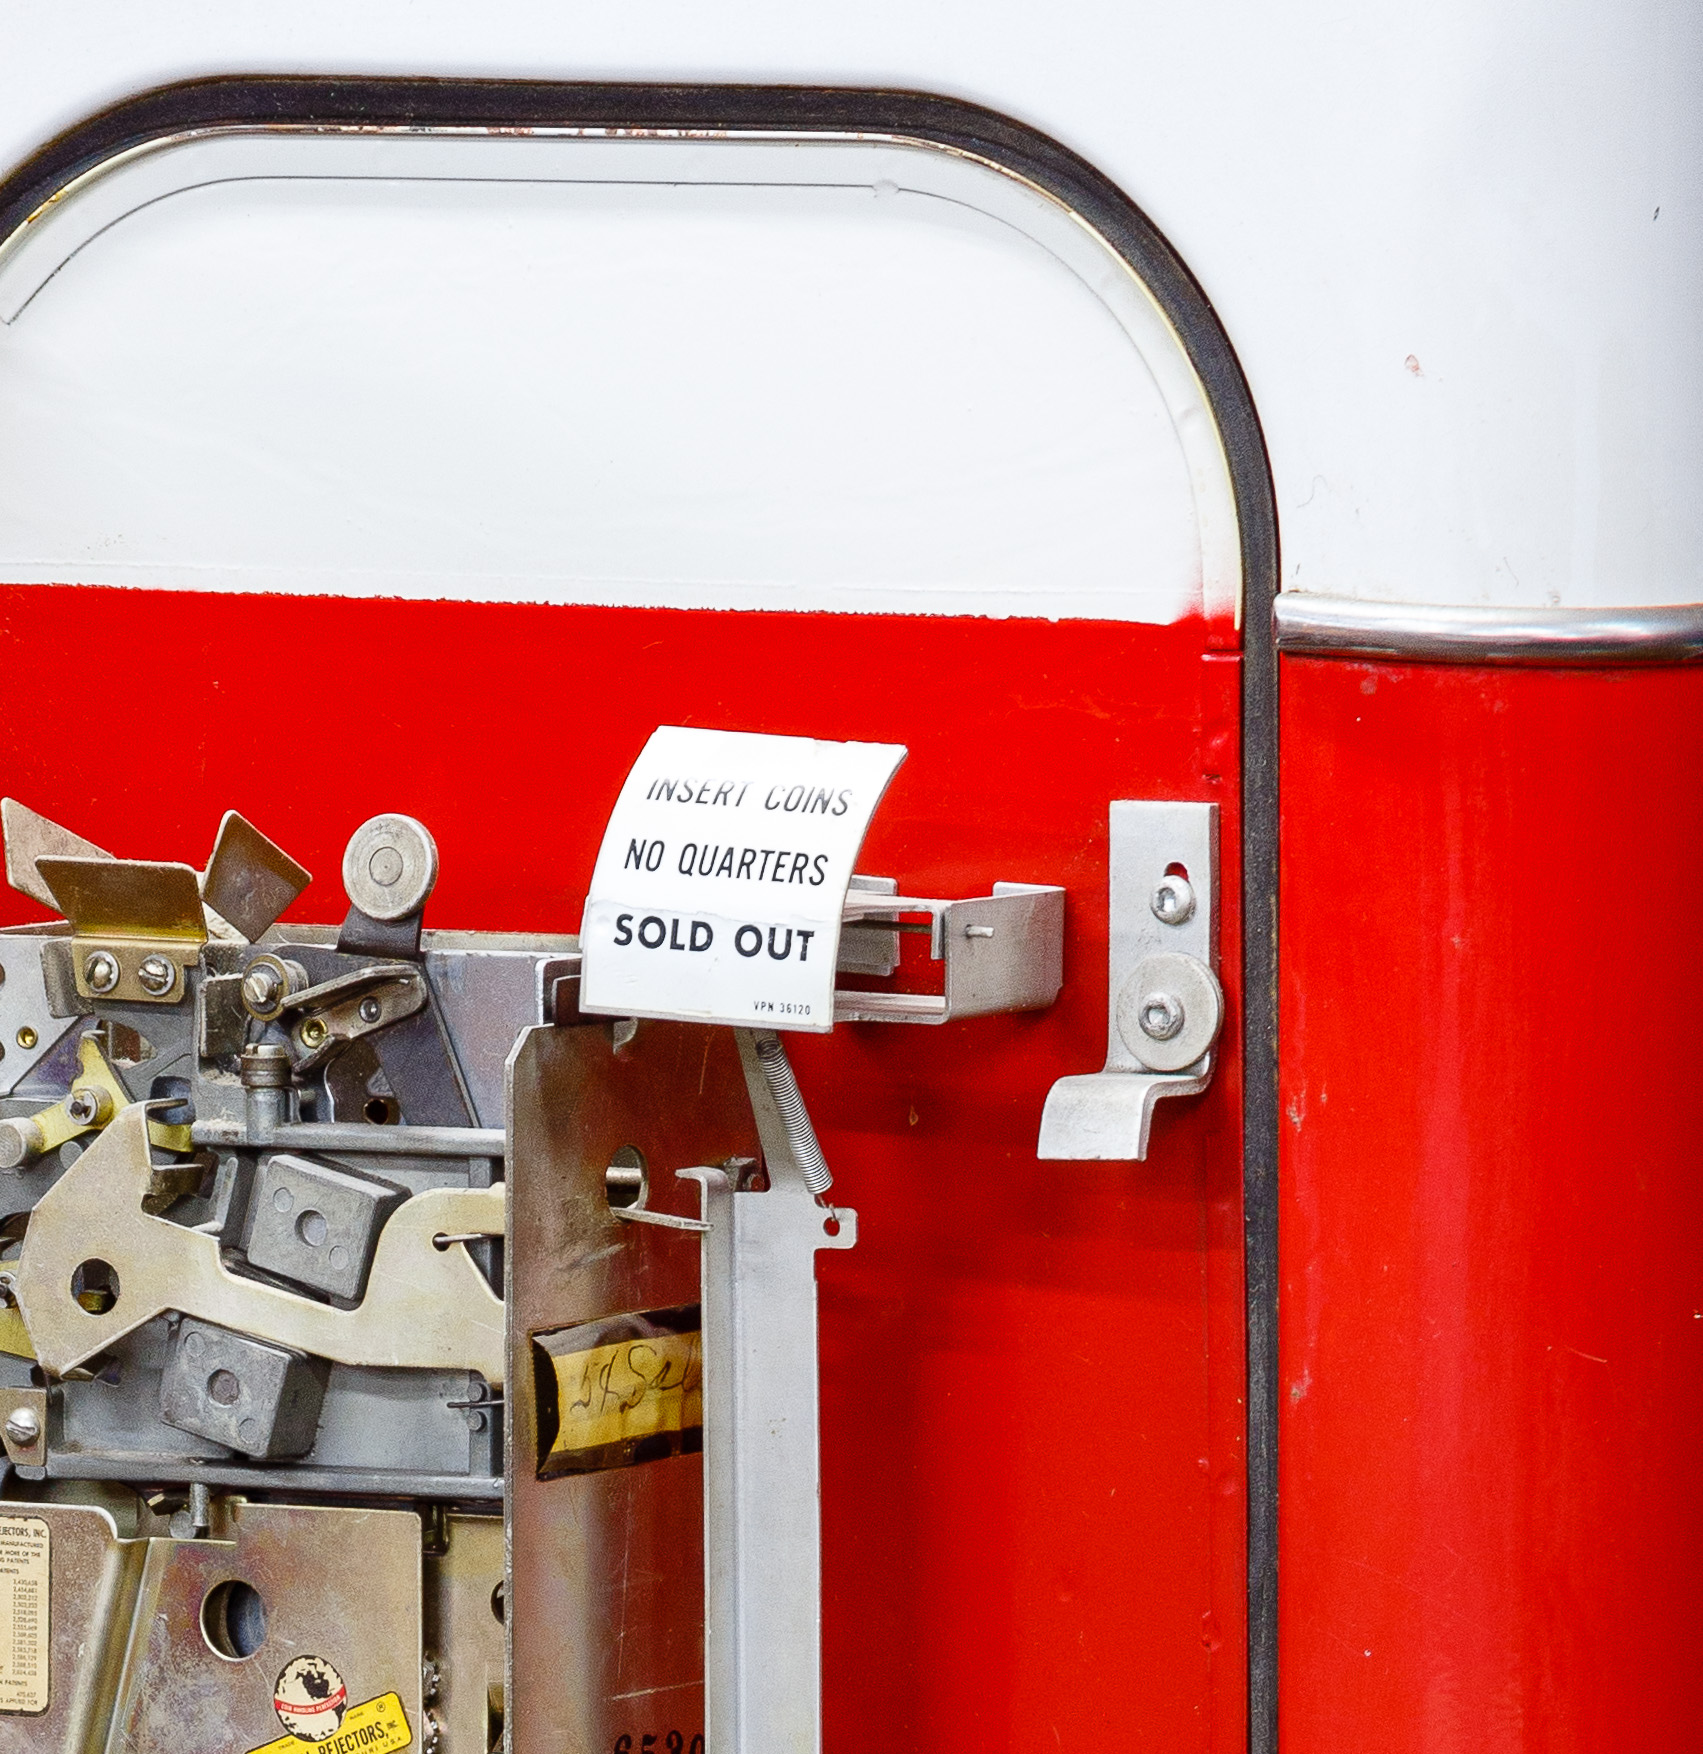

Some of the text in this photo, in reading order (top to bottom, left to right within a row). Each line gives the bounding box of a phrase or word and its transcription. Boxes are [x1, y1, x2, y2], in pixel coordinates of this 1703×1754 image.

[646, 778, 854, 817] INSERT COINS
[624, 837, 829, 886] NO QUARTERS
[613, 914, 816, 962] SOLD OUT
[780, 1003, 811, 1015] 36120
